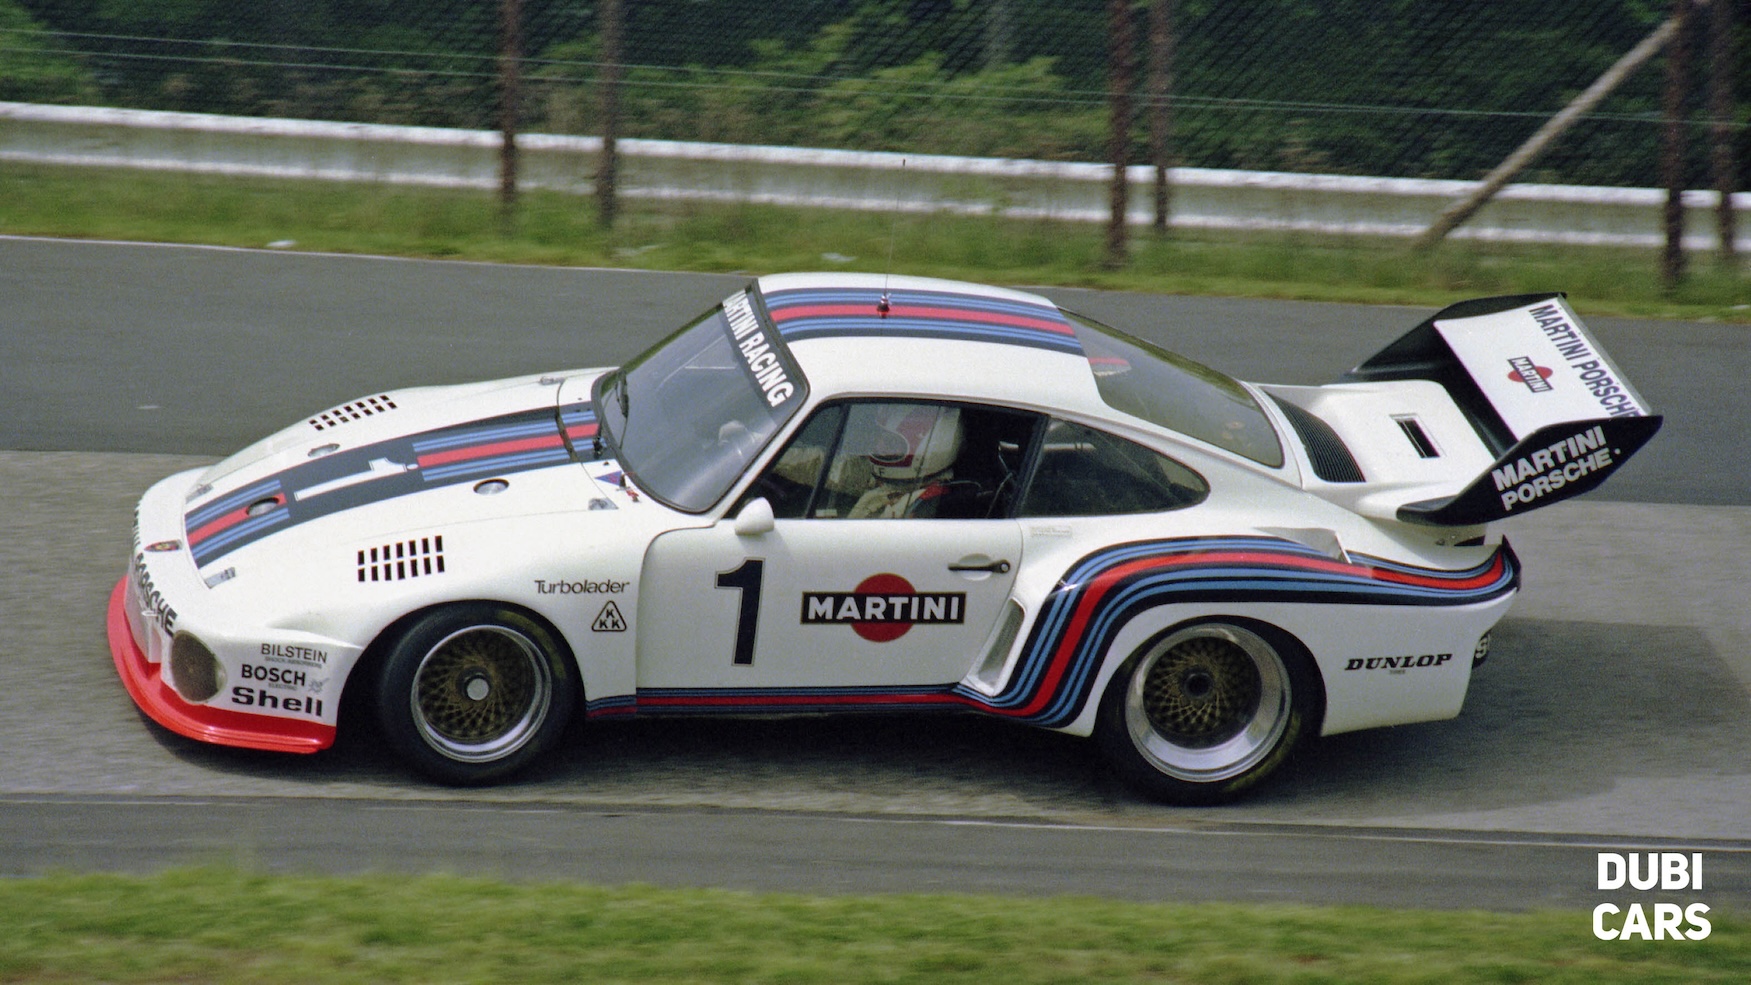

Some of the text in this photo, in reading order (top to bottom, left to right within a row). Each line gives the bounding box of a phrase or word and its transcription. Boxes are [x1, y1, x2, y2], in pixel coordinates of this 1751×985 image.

[1529, 304, 1592, 369] MARTINI
[739, 331, 794, 407] RACING
[1509, 357, 1552, 392] MARTINI
[1492, 426, 1606, 491] MARTINI
[293, 457, 407, 502] 1
[1501, 449, 1612, 511] PORSCHE
[534, 579, 630, 594] Turbolader
[715, 557, 765, 667] 1
[807, 596, 961, 621] MARTINI
[261, 643, 328, 664] BILSTEIN
[1344, 653, 1453, 671] DUNLOP
[241, 663, 306, 687] BOSCH
[231, 686, 323, 717] Shell
